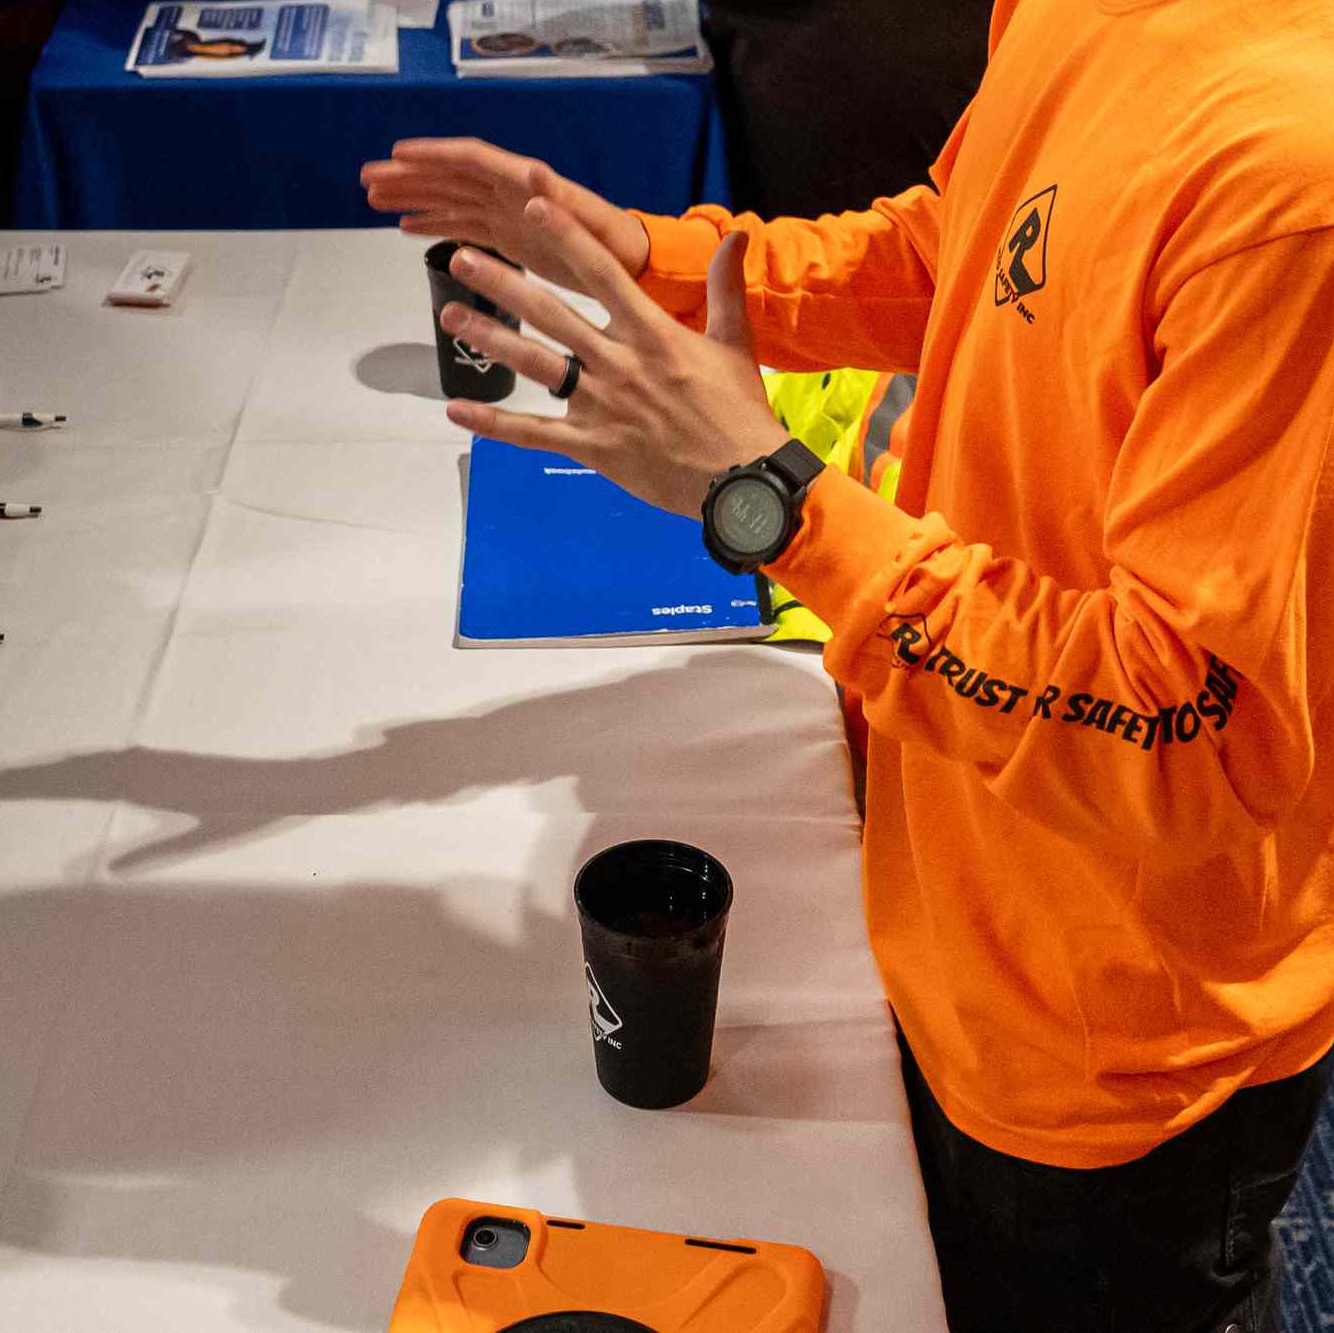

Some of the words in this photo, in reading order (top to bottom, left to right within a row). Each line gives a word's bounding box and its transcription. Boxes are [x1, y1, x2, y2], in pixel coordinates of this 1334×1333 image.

[651, 604, 713, 617] Staples
[923, 644, 1029, 714] TRUST
[1033, 684, 1061, 720] R
[1061, 692, 1162, 751] SAFET
